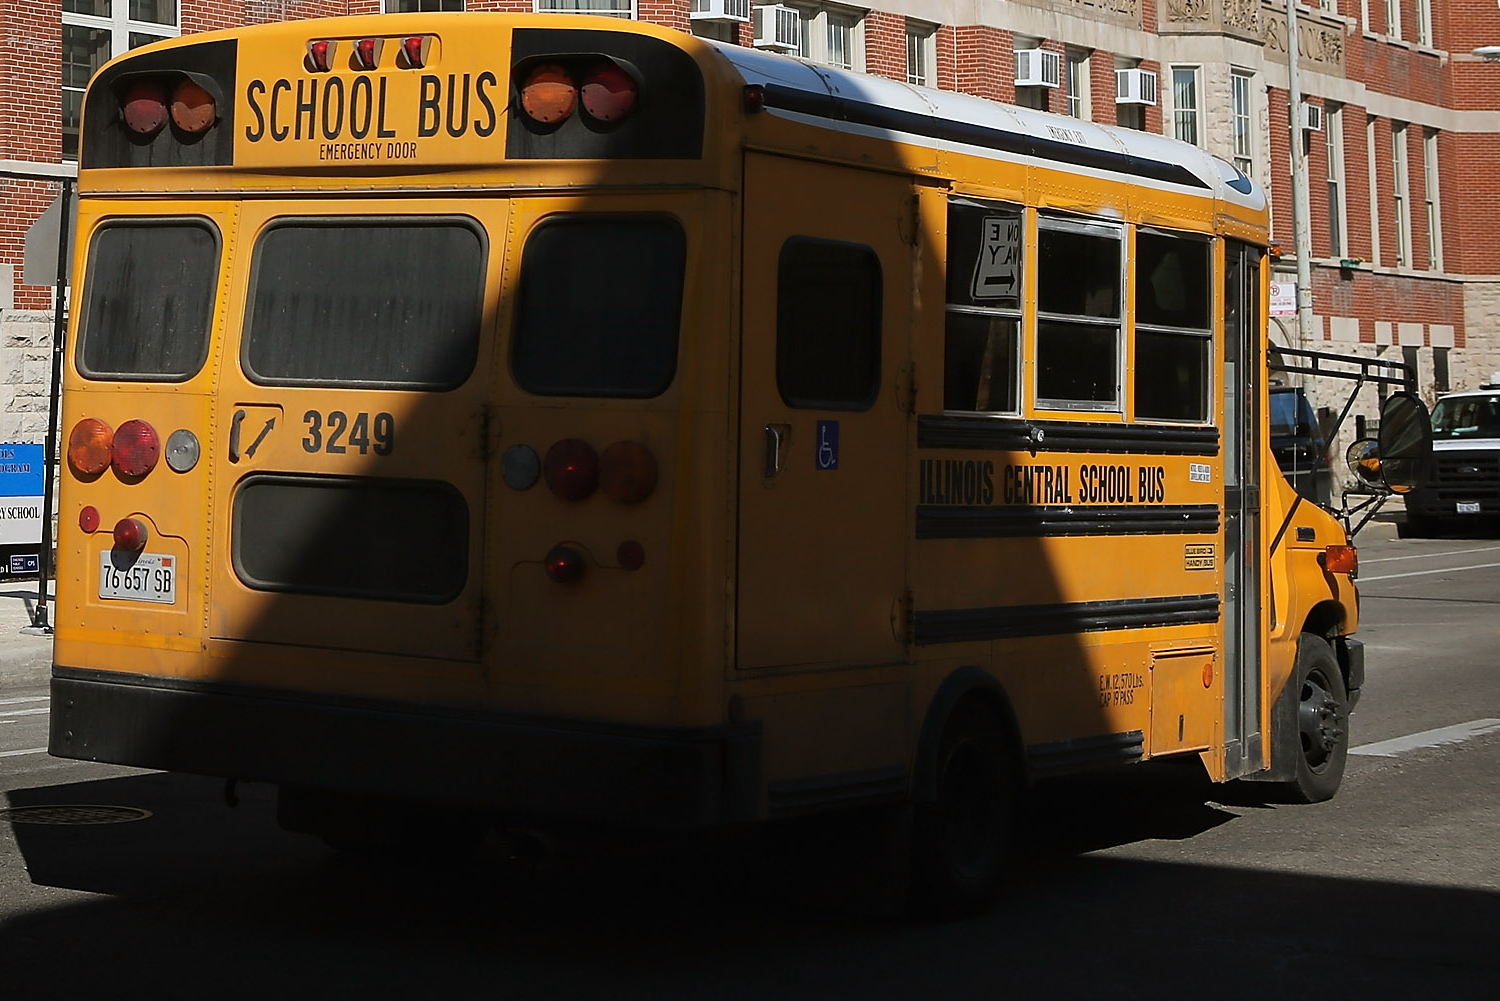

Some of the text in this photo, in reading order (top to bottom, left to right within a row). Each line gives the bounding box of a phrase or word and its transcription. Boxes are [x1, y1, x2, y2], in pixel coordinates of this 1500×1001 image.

[1266, 17, 1323, 62] SCOOL
[245, 71, 497, 143] SCHOOL BUS
[319, 142, 417, 160] EMERGENCY DOOR
[302, 410, 395, 456] 3249
[920, 460, 1164, 504] ILLINOIS CENTRAL SCHOOL BUS
[8, 506, 40, 519] SCHOOL
[104, 565, 171, 592] 76 657 SB
[1100, 692, 1111, 707] CAP
[1120, 690, 1134, 706] PASS
